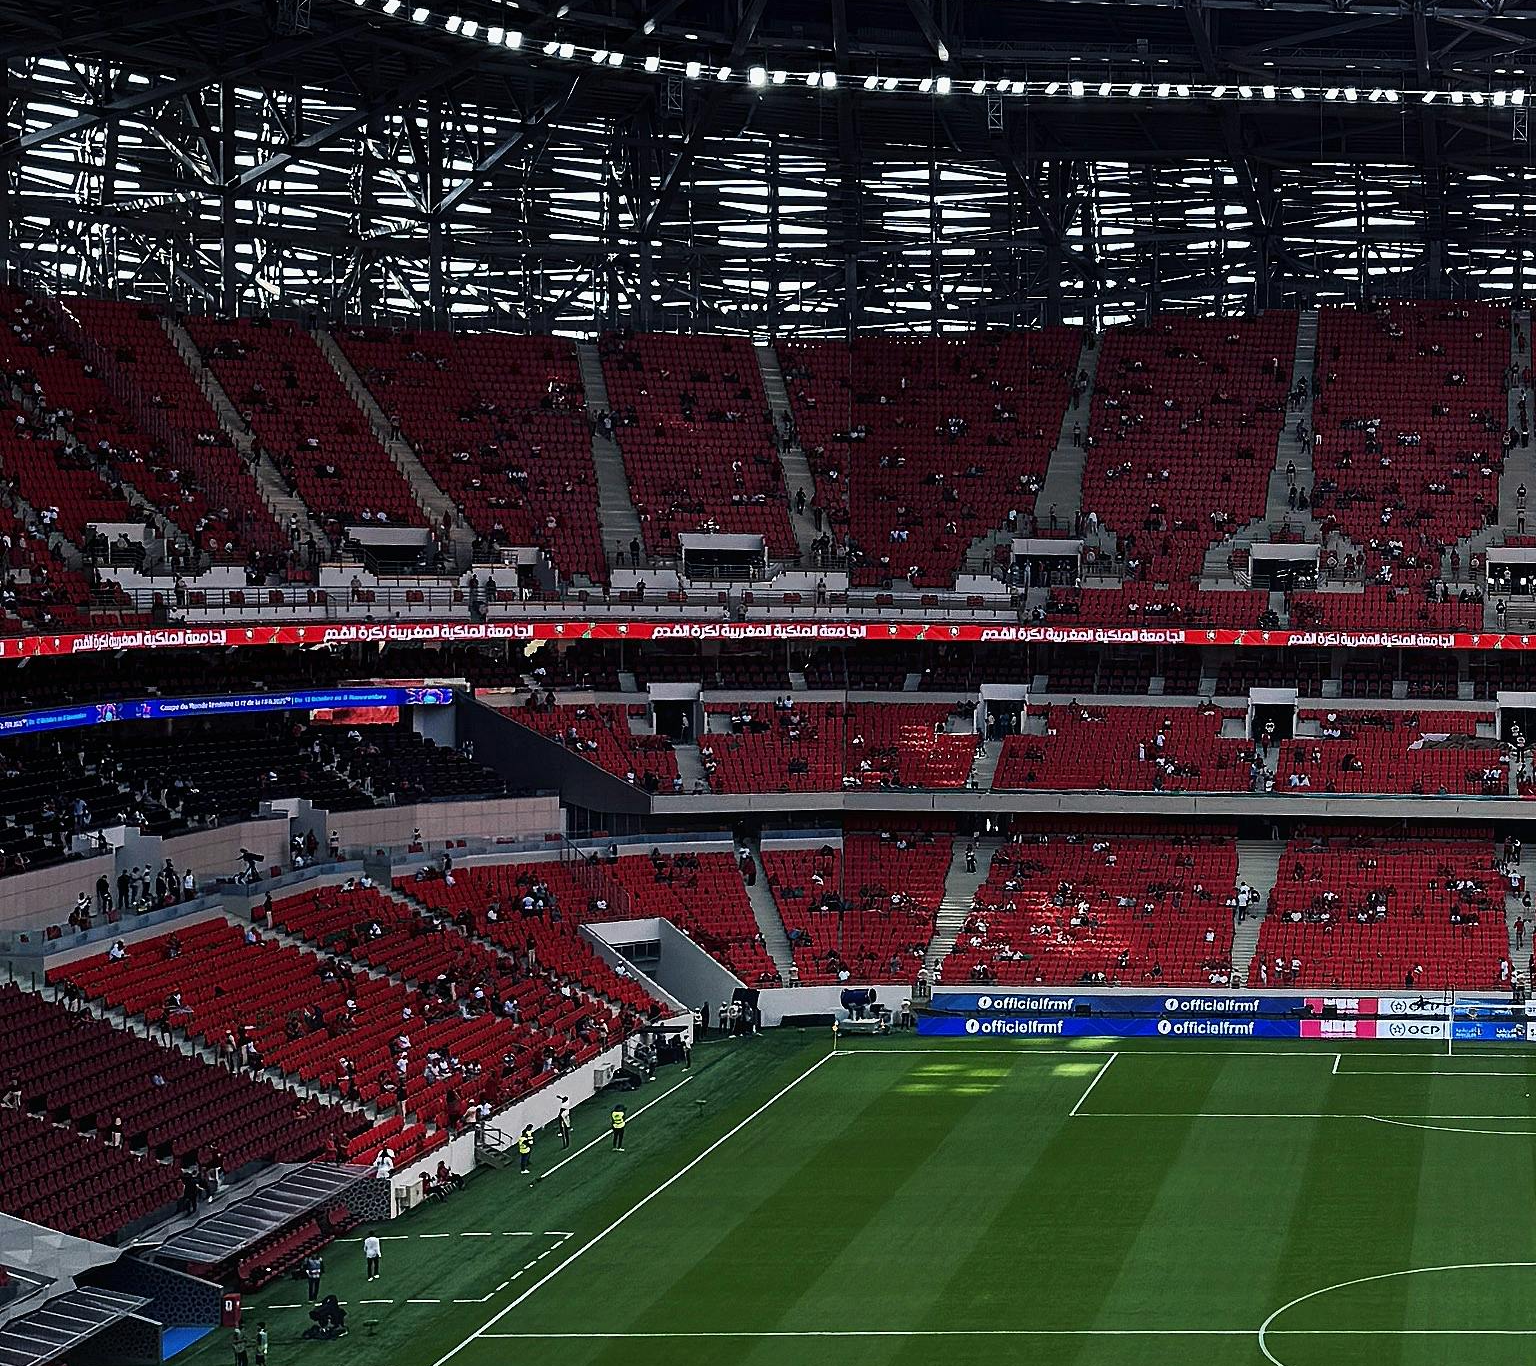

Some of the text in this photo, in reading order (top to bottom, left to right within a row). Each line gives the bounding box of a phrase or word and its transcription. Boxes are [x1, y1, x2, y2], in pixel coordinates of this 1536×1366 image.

[324, 625, 356, 642] القدم
[441, 624, 484, 640] الملكية
[652, 624, 688, 639] القدم
[774, 624, 817, 639] الملكية
[981, 628, 1016, 642] القدم
[1096, 628, 1138, 643] الملكية
[1288, 634, 1316, 646] القدم
[1381, 634, 1415, 647] الملكية
[994, 997, 1074, 1010] officialfrmf
[1181, 998, 1260, 1011] officialfrmf
[982, 1020, 1064, 1034] officialfrmf
[1174, 1021, 1254, 1035] officialfrmf
[1408, 1025, 1440, 1035] OCP
